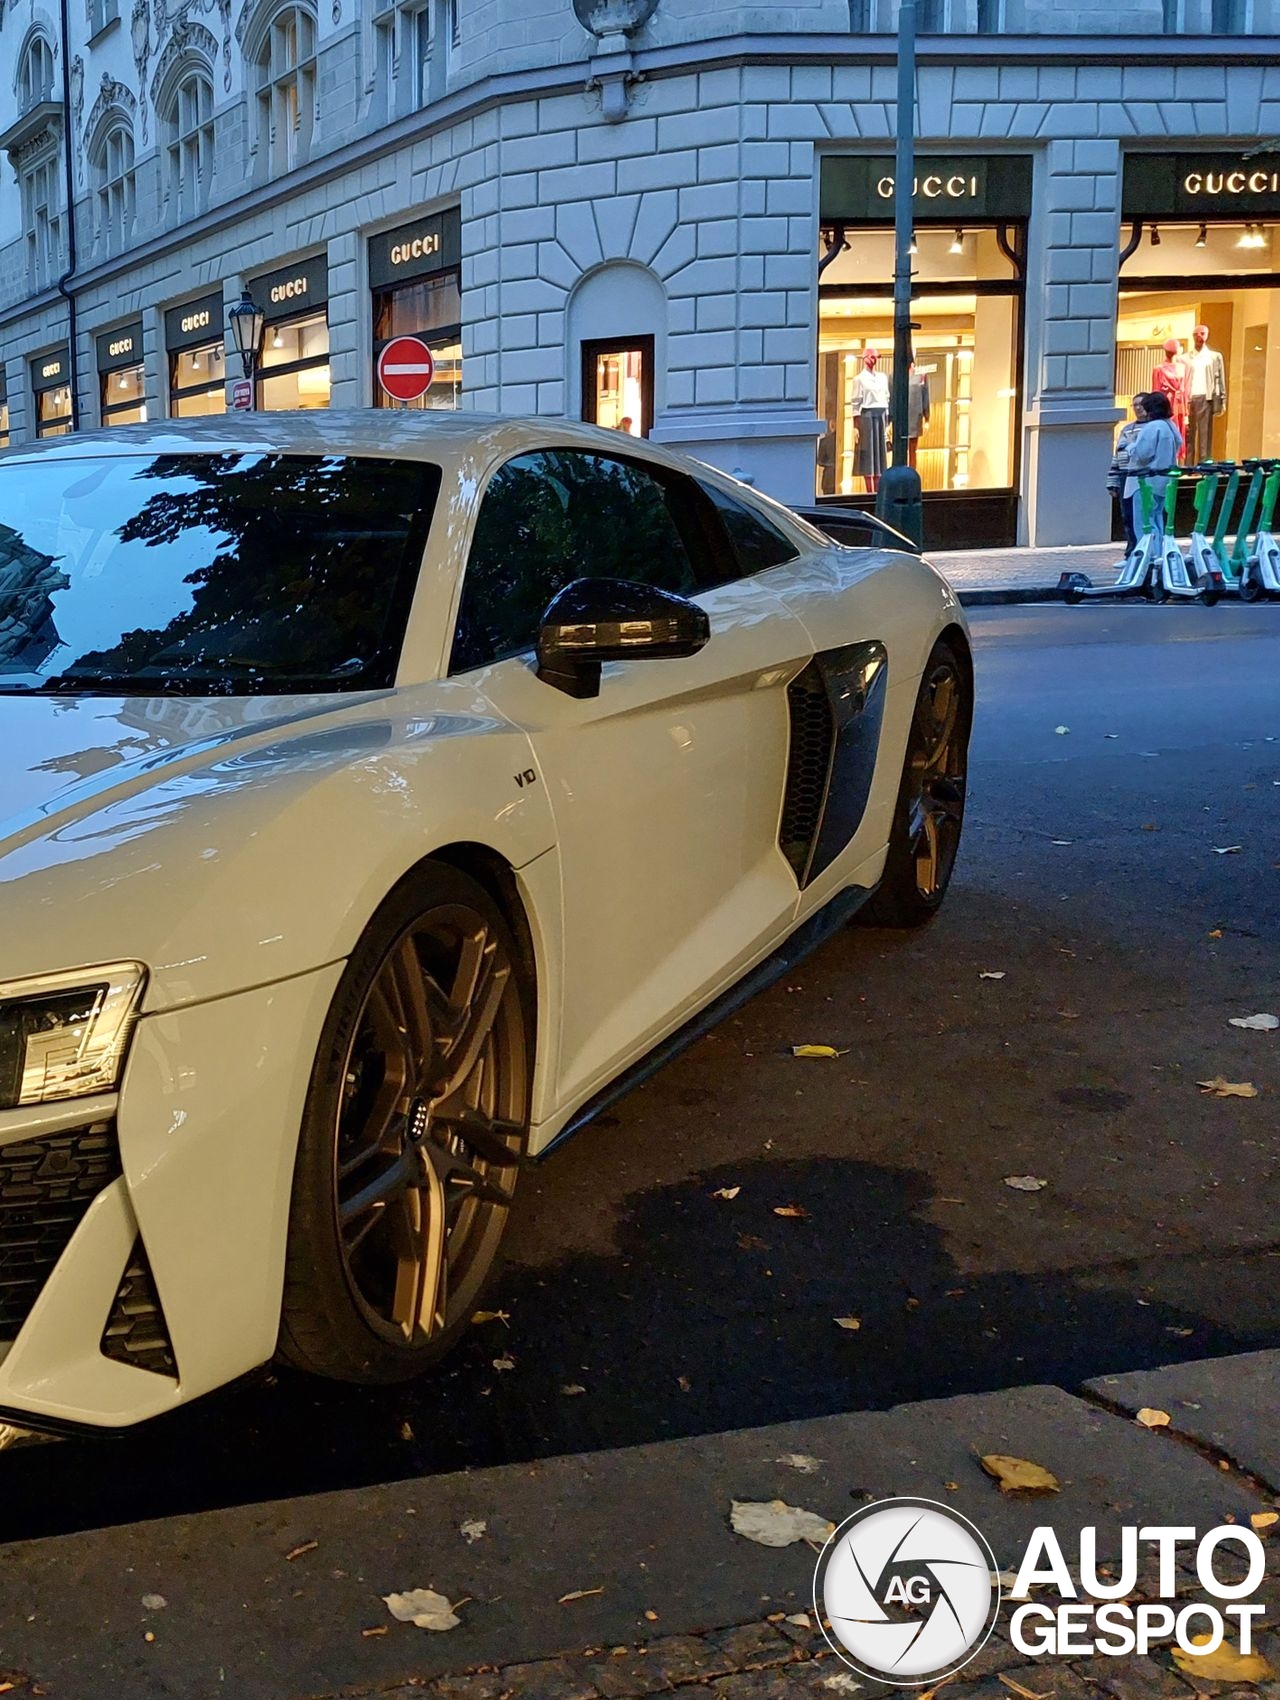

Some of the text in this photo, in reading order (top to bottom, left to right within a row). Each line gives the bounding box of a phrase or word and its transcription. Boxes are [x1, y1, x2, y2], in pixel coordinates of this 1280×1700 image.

[1185, 172, 1278, 194] GUCCI
[391, 233, 439, 265] GUCCI
[271, 277, 307, 303] GUCCI
[181, 311, 209, 333] GUCCI
[109, 337, 132, 357] GUCCI
[42, 361, 60, 378] GUCCI
